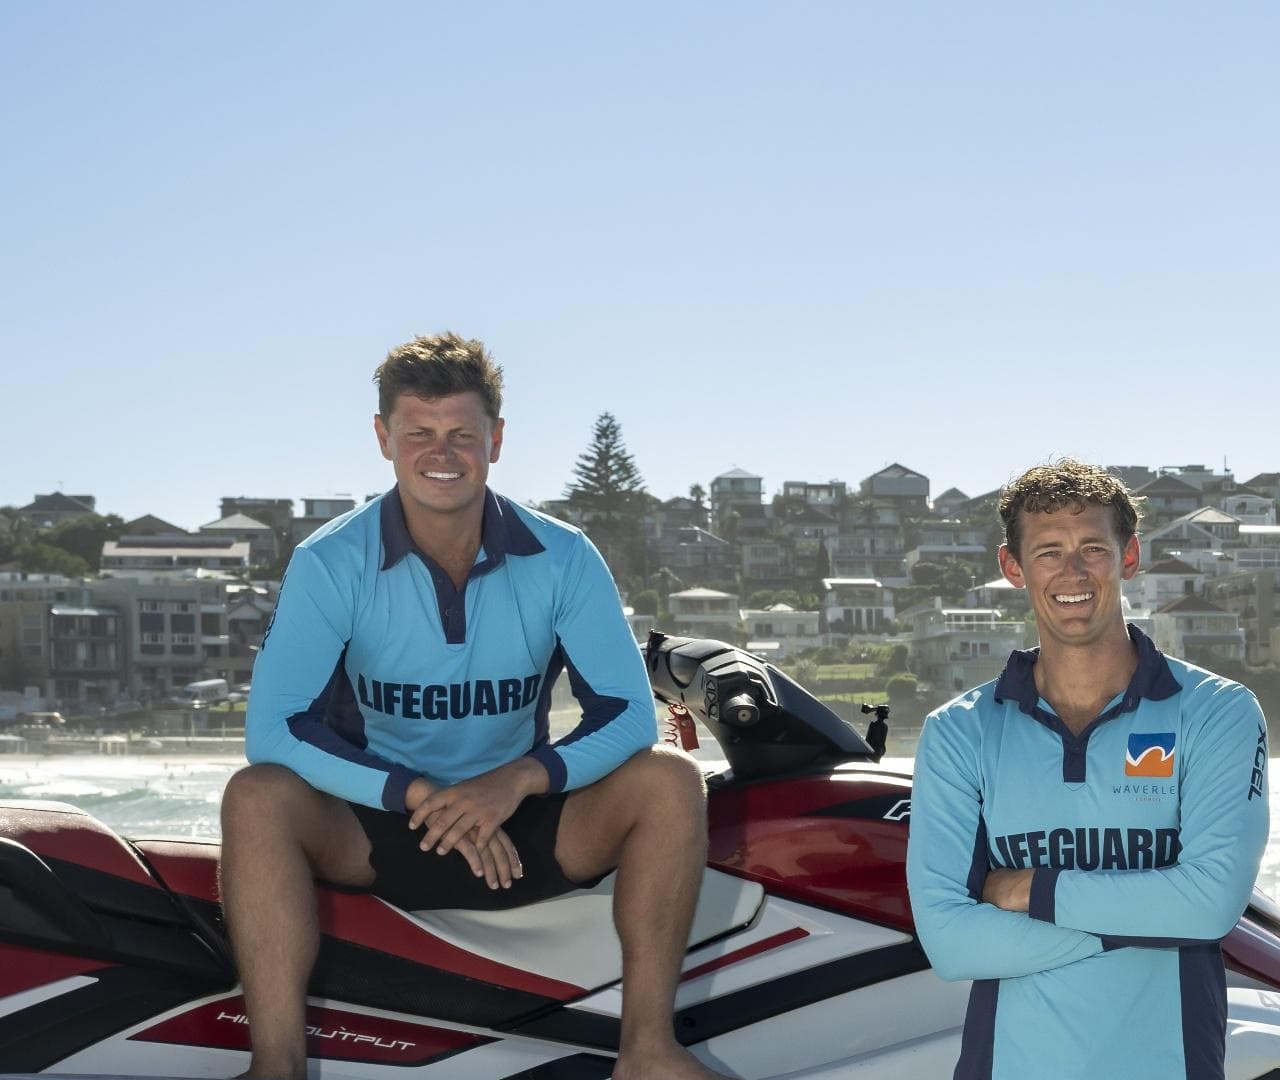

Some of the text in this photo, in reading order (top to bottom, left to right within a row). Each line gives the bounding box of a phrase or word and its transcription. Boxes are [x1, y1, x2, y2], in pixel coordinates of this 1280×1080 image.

[358, 672, 542, 720] LIFEGUARD
[1247, 722, 1267, 801] XCEL
[1112, 785, 1176, 795] WAVERLE
